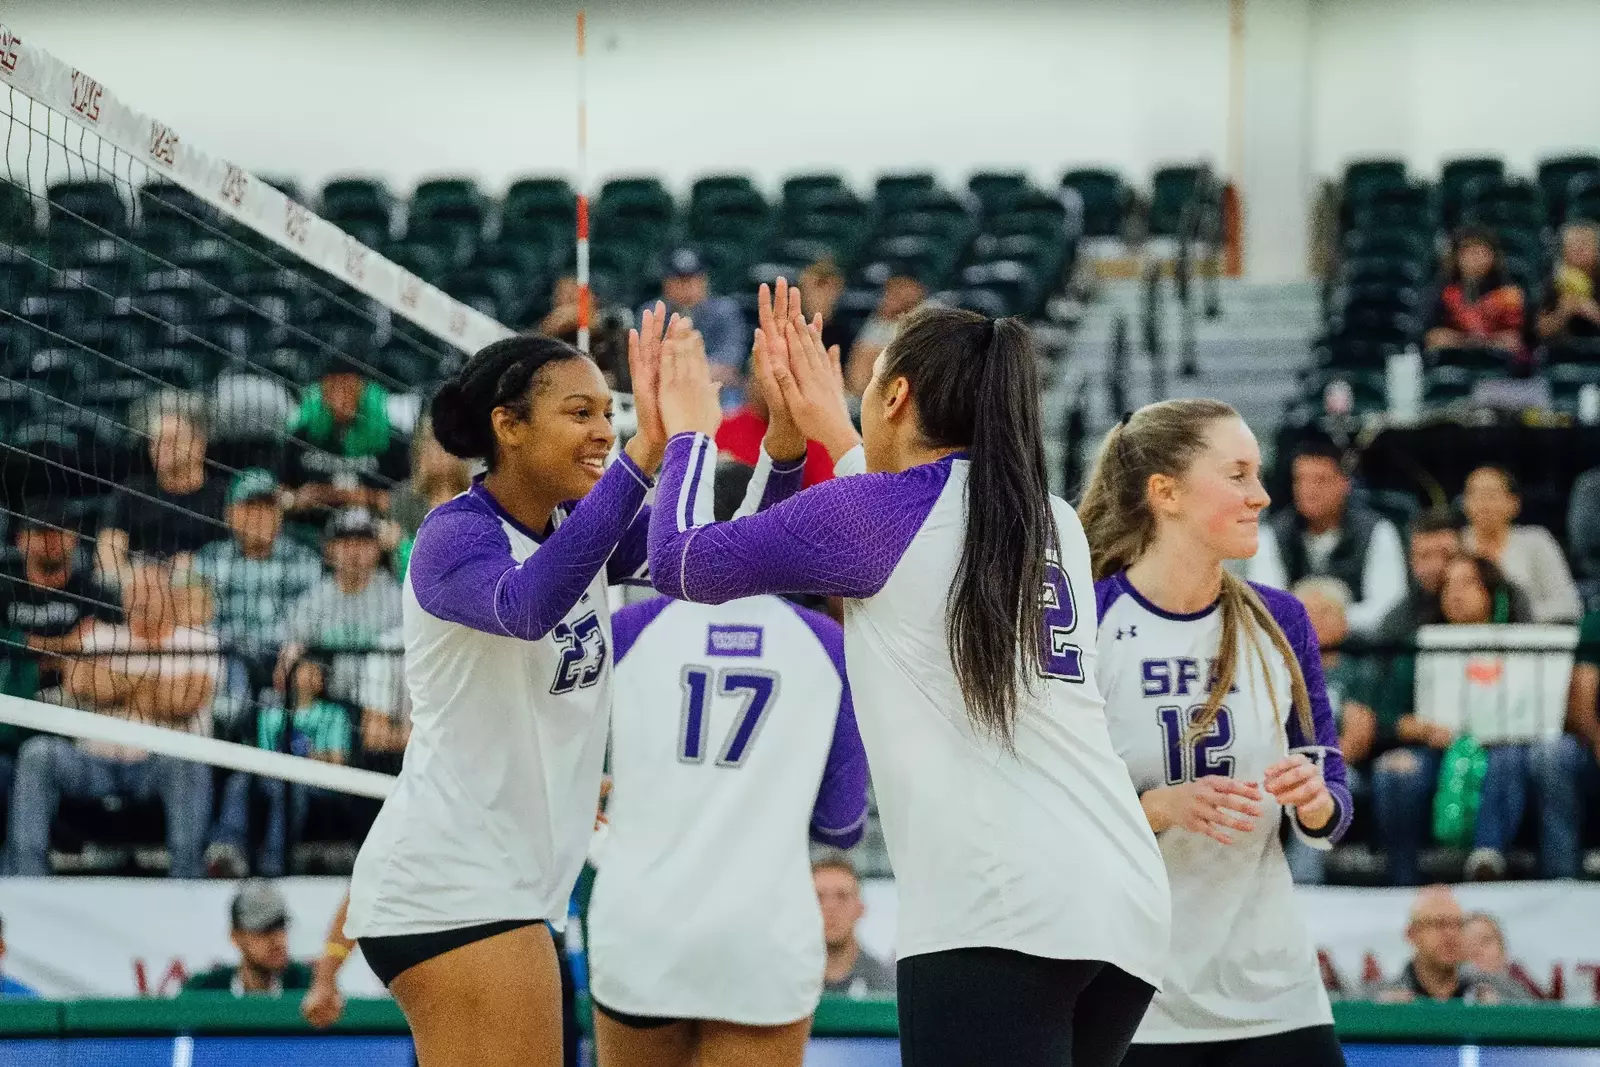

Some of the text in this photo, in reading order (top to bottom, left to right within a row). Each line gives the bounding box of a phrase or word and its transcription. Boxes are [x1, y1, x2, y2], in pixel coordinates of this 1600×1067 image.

[549, 609, 606, 695] 23
[1036, 558, 1085, 684] 2
[677, 664, 781, 769] 17
[1156, 704, 1236, 786] 12
